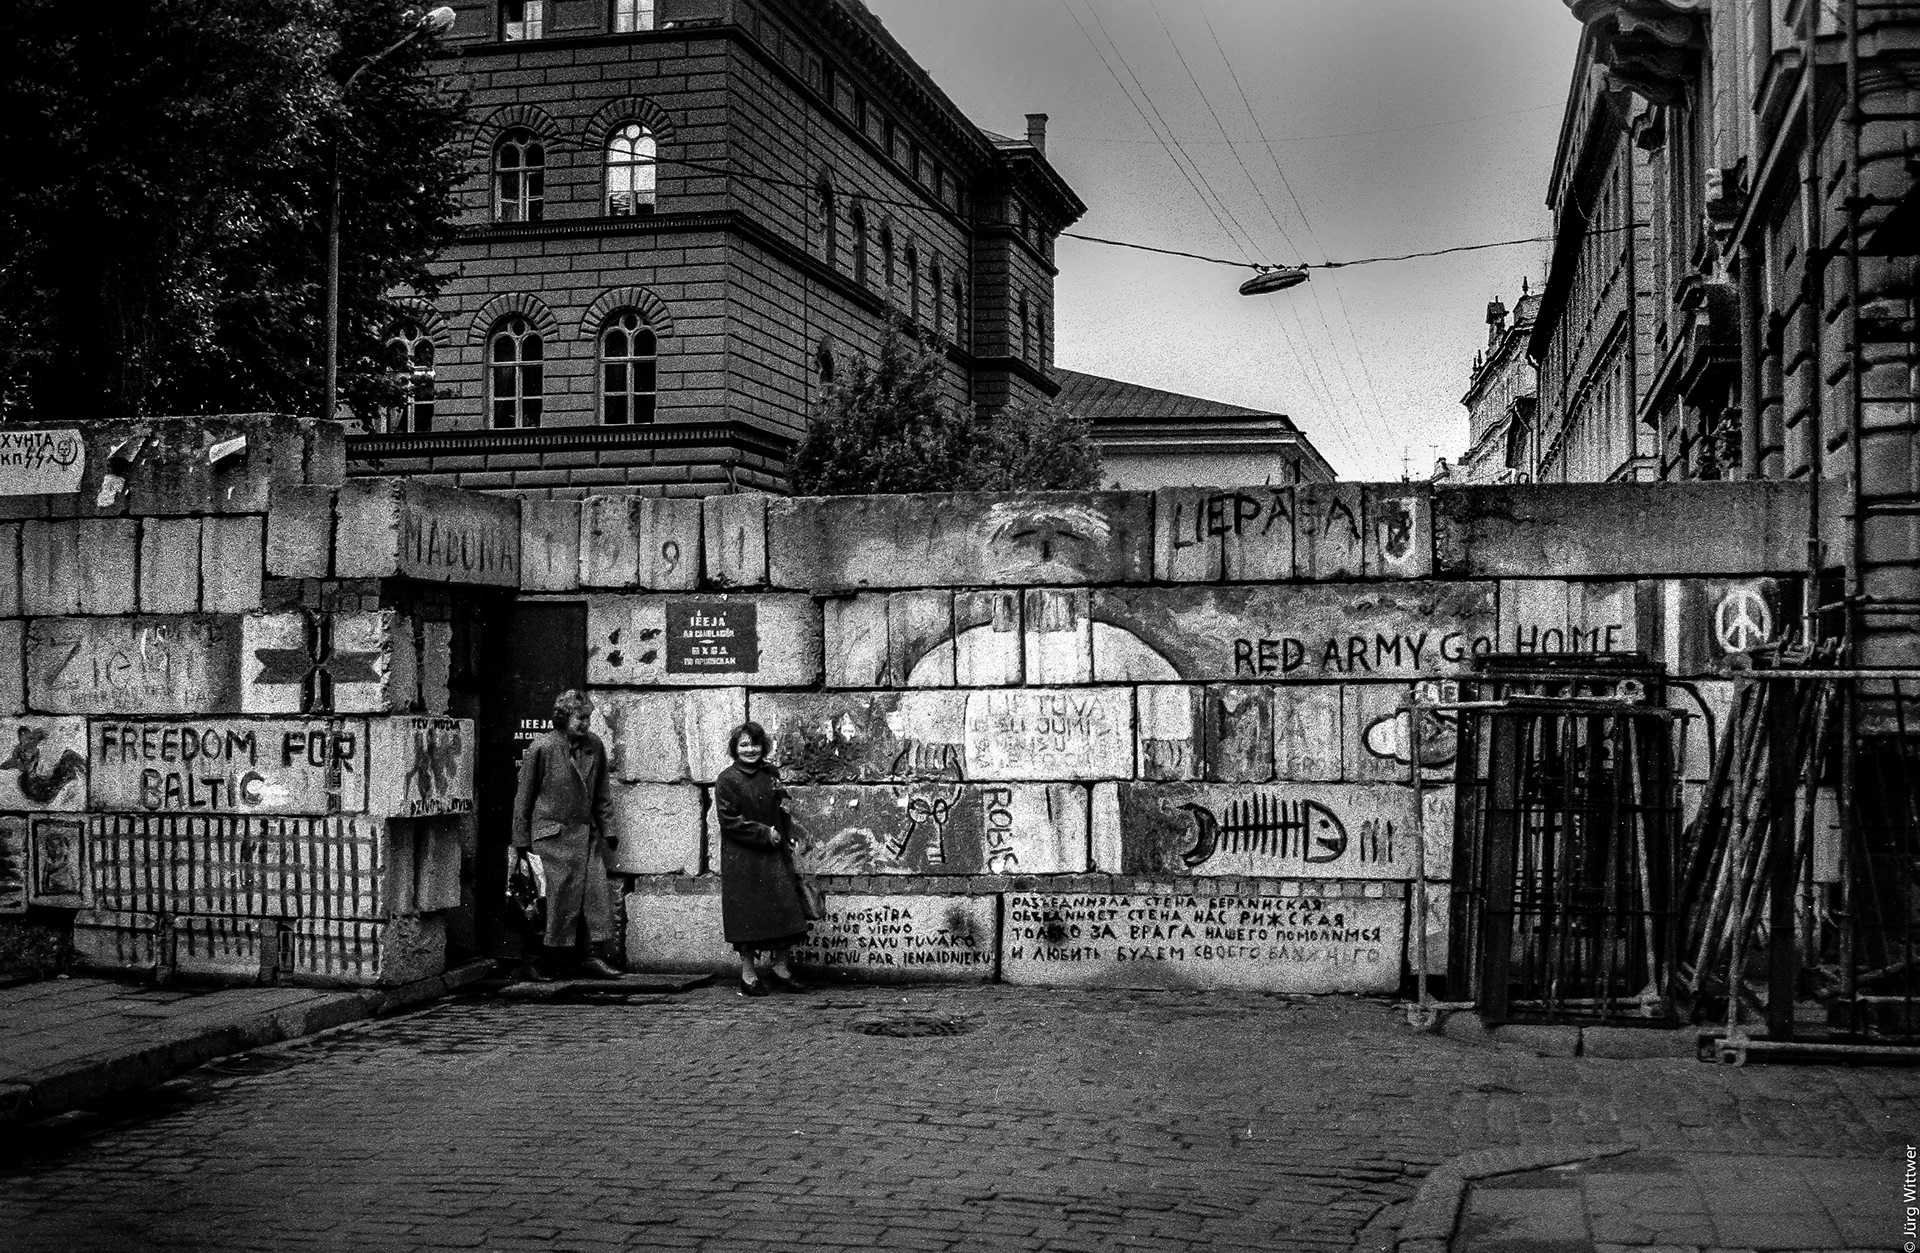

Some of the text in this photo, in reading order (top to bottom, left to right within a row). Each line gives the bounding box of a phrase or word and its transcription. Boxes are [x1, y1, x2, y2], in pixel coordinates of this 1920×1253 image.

[1234, 637, 1305, 676] RED
[1323, 633, 1428, 672] ARMY
[1517, 624, 1622, 654] HOME
[520, 719, 555, 729] IEEJA
[101, 725, 355, 772] FREEDOM FOR
[140, 767, 266, 810] BALTIC
[1145, 896, 1198, 908] СТЕНА
[1128, 909, 1181, 921] СТЕНА
[1193, 910, 1228, 924] НАС
[1240, 911, 1344, 928] РИЖСКАЯ
[858, 935, 898, 951] SAVU
[904, 929, 976, 948] TUVĀKO
[1012, 924, 1081, 941] ТОЛКО
[1090, 923, 1118, 940] ЗА
[1130, 924, 1196, 940] ВРАГА
[1205, 927, 1268, 941] НАШЕГО
[824, 951, 861, 965] DIEVU
[867, 952, 896, 965] PAR
[1011, 945, 1024, 959] И
[1033, 947, 1102, 961] ЛЮБИТЬ
[1117, 946, 1185, 961] БУДЕМ
